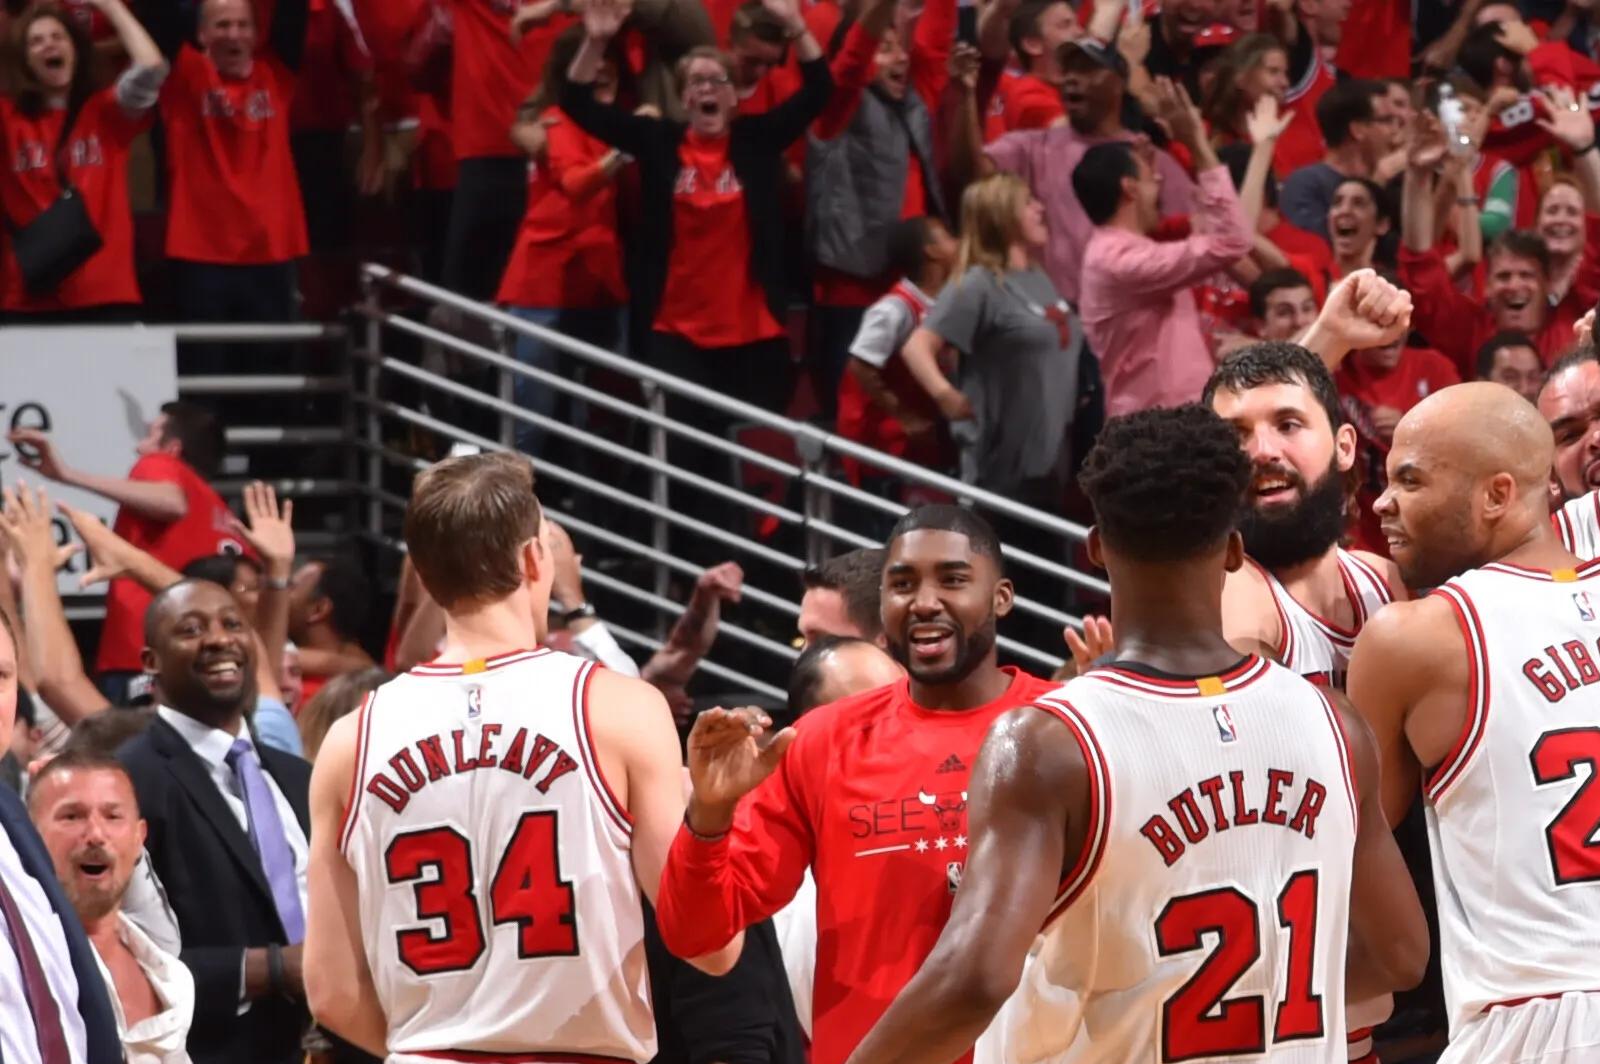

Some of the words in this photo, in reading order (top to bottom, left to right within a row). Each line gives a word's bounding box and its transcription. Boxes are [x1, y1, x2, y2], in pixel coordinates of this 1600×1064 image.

[366, 723, 580, 815] DUNLEAVY
[848, 797, 926, 839] SEE
[1139, 768, 1328, 868] BUTLER
[384, 809, 580, 977] 34
